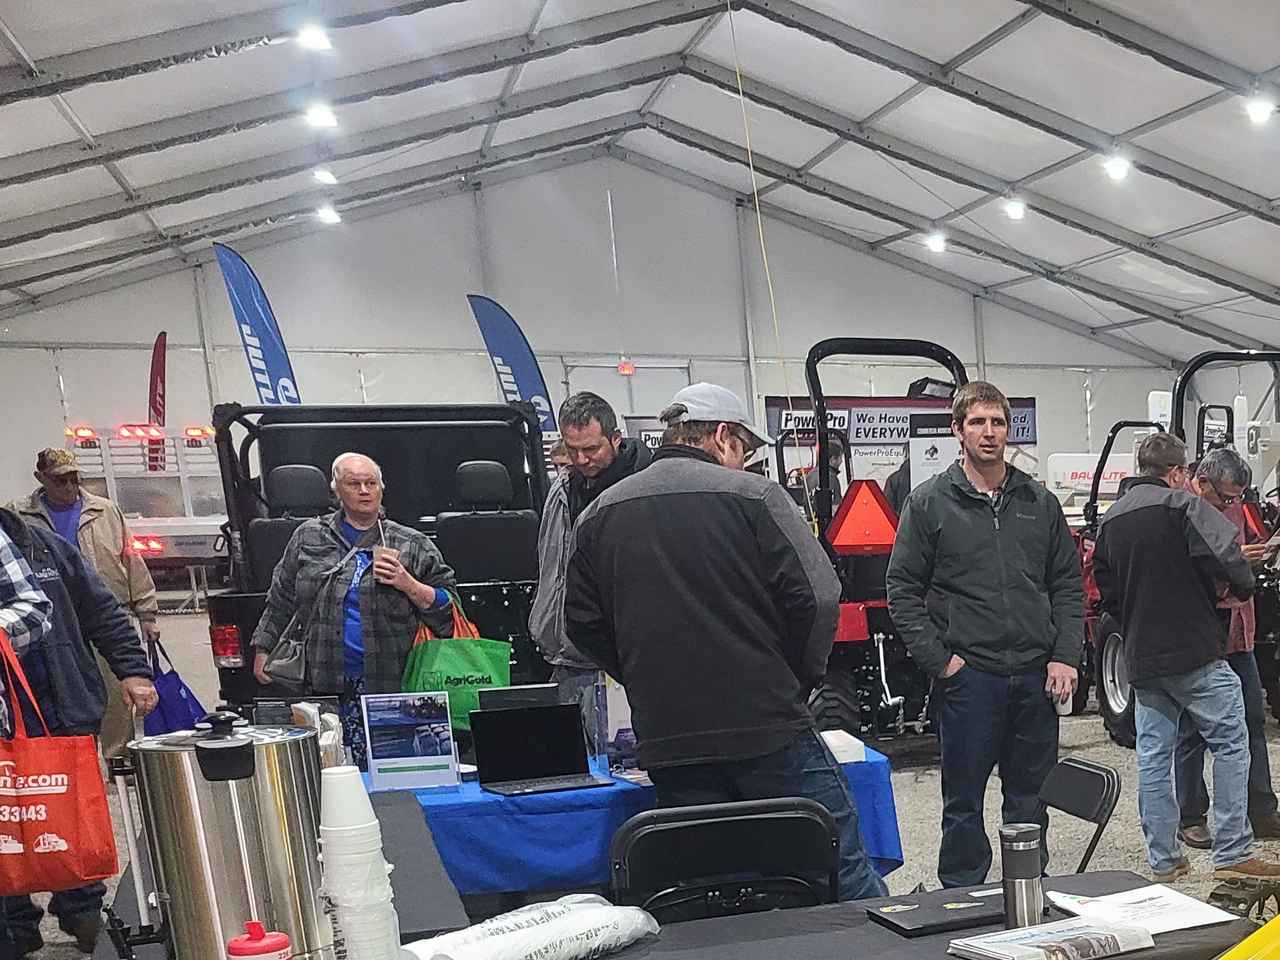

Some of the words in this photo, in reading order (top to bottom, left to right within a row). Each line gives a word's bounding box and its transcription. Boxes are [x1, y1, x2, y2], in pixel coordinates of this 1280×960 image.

[784, 412, 846, 428] PowPro
[856, 413, 875, 424] We
[879, 413, 909, 424] Have
[855, 427, 909, 439] EVERYW
[1016, 426, 1030, 438] IT!
[444, 674, 493, 686] AgriGold
